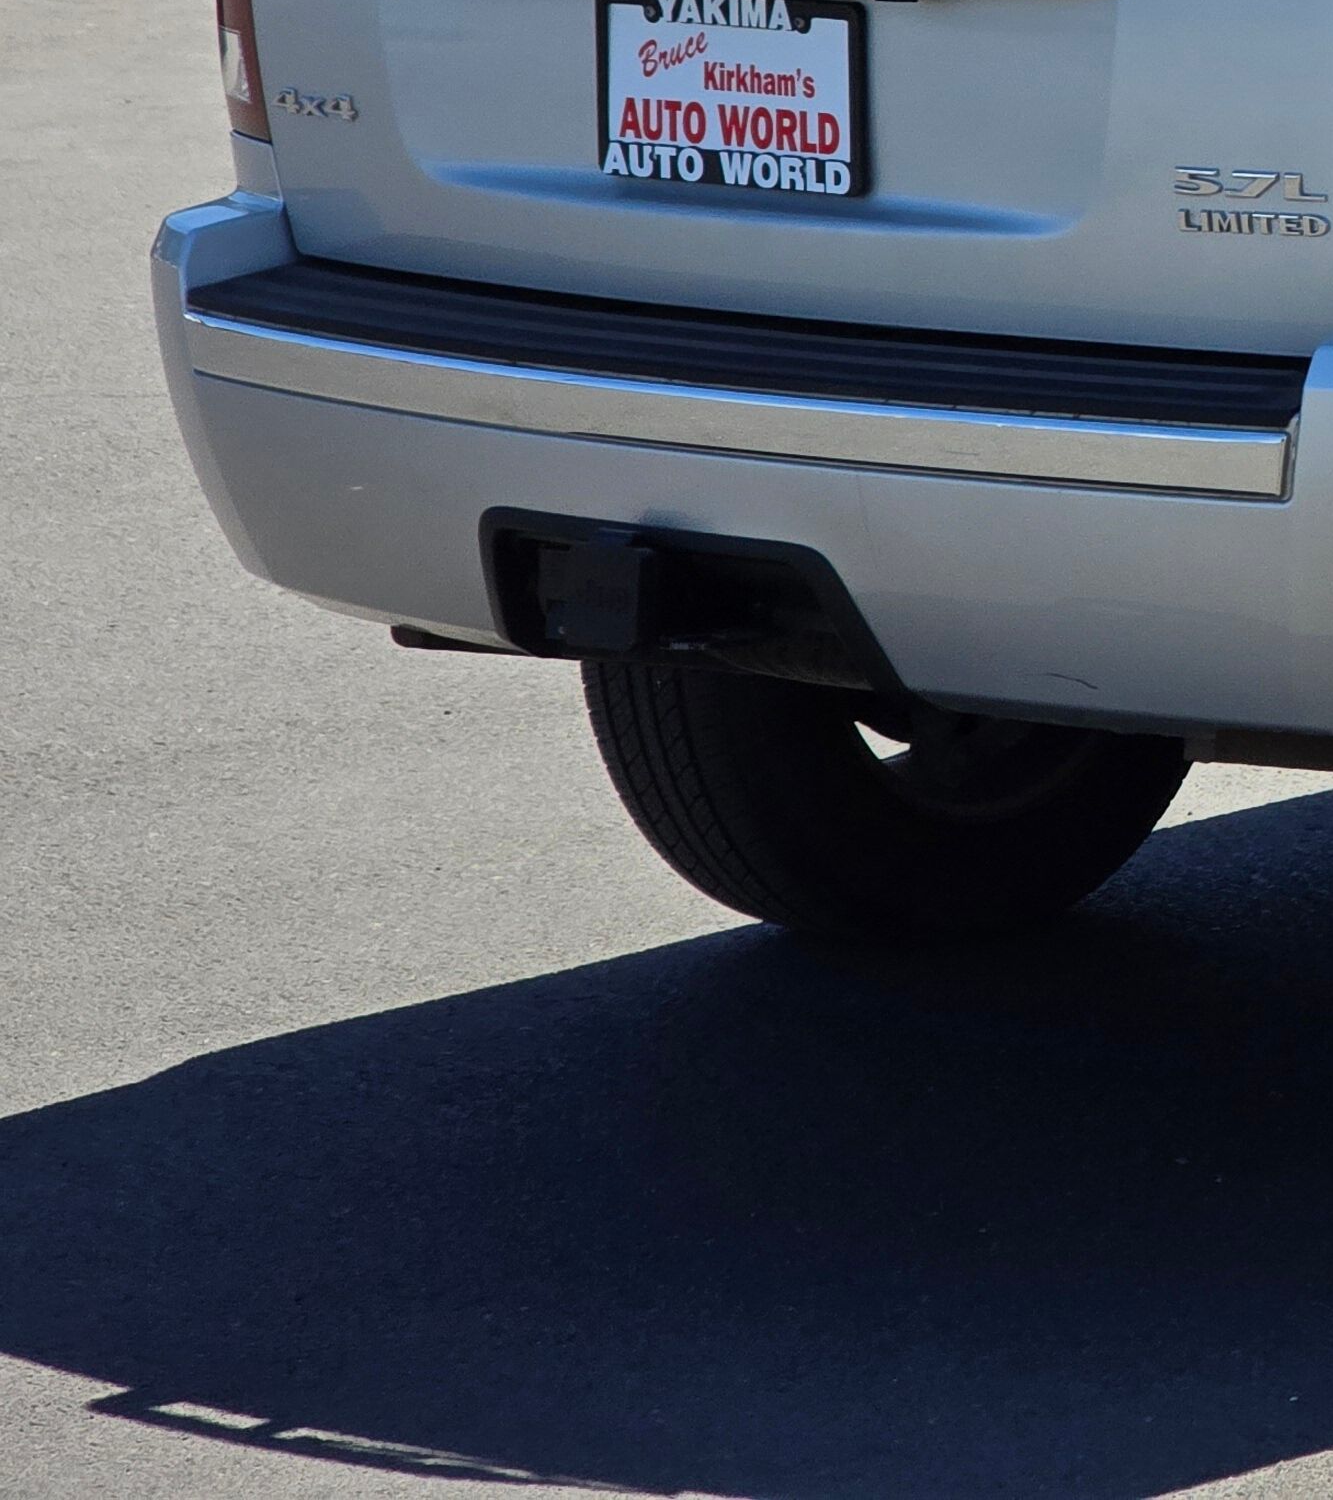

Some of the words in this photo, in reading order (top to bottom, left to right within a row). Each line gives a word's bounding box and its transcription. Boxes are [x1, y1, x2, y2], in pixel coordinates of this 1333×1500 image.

[638, 31, 709, 78] Bruce
[702, 61, 816, 99] Kirkham's
[270, 86, 358, 122] 4x4
[618, 97, 707, 144] AUTO
[717, 103, 840, 155] WORLD
[602, 142, 705, 182] AUTO
[720, 151, 851, 196] WORLD
[1178, 208, 1331, 238] LIMITED
